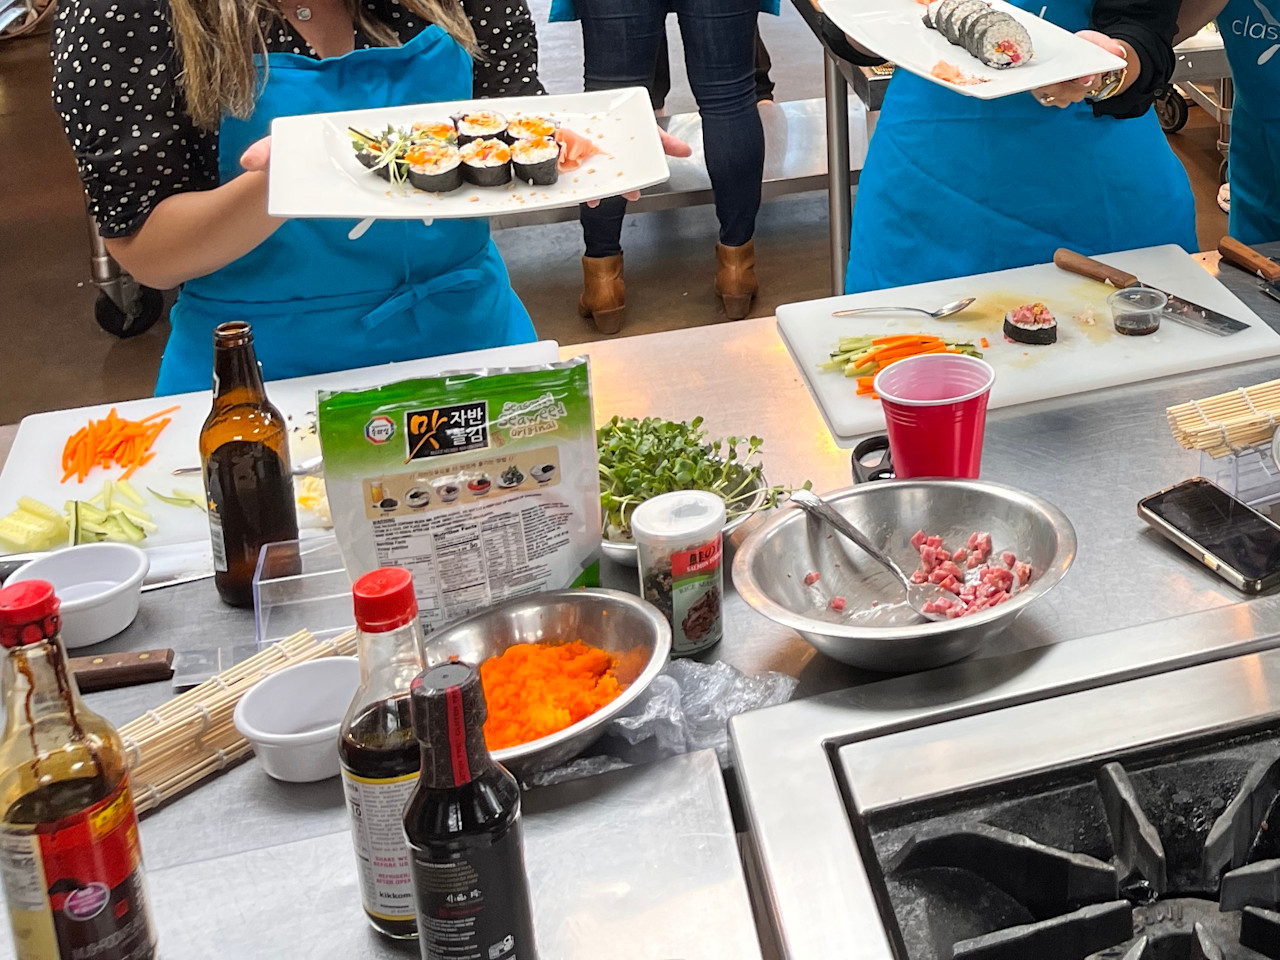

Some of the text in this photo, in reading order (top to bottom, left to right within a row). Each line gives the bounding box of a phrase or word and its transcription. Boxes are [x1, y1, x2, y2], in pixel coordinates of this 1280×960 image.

[450, 407, 483, 427] 자반
[404, 409, 448, 464] 맛
[379, 890, 413, 899] kikkom
